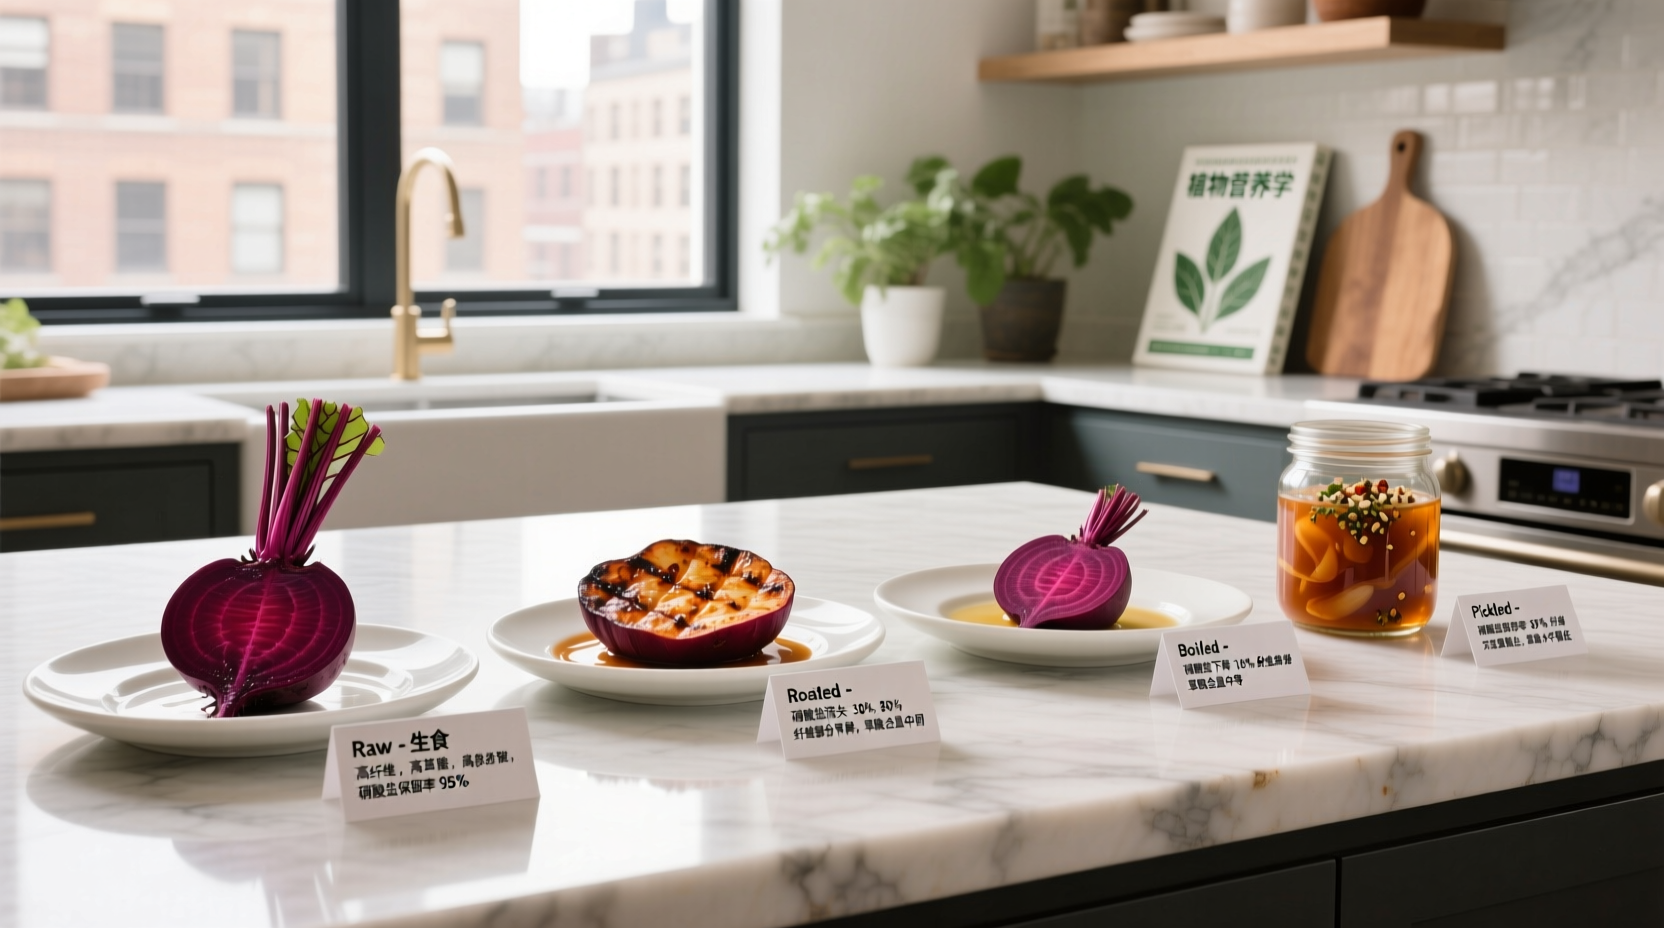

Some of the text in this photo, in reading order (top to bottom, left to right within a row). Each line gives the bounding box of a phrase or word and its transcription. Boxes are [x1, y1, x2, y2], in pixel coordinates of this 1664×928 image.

[1188, 170, 1294, 198] 植物营养学
[1471, 601, 1512, 618] Pickled
[1178, 640, 1220, 657] Boiled
[352, 740, 393, 758] Raw
[410, 729, 450, 753] 生食
[439, 774, 470, 790] 95%
